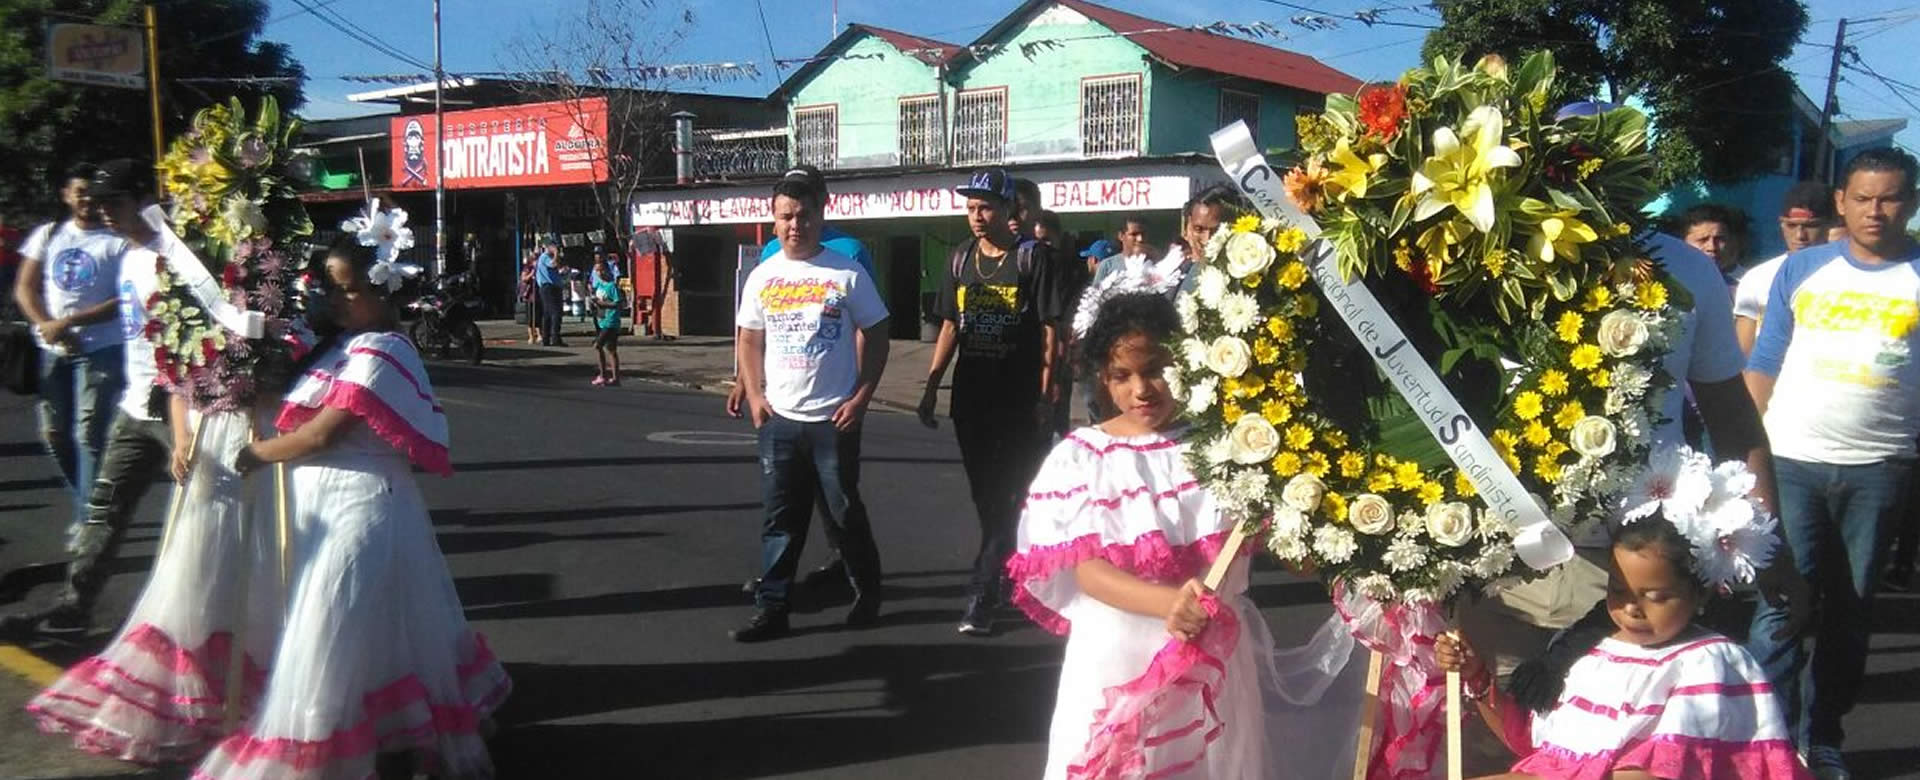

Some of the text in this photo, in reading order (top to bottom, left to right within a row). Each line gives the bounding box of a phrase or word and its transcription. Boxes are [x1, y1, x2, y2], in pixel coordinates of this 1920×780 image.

[443, 131, 549, 179] ONTRATISTA
[719, 195, 772, 217] LAVAD
[825, 191, 864, 216] MOR
[890, 189, 941, 211] AUTO
[1052, 178, 1151, 208] BALMOR
[1301, 239, 1362, 319] Nacional
[1357, 317, 1381, 343] de
[1374, 339, 1449, 427] Juventud
[1439, 414, 1518, 521] Sandinista
